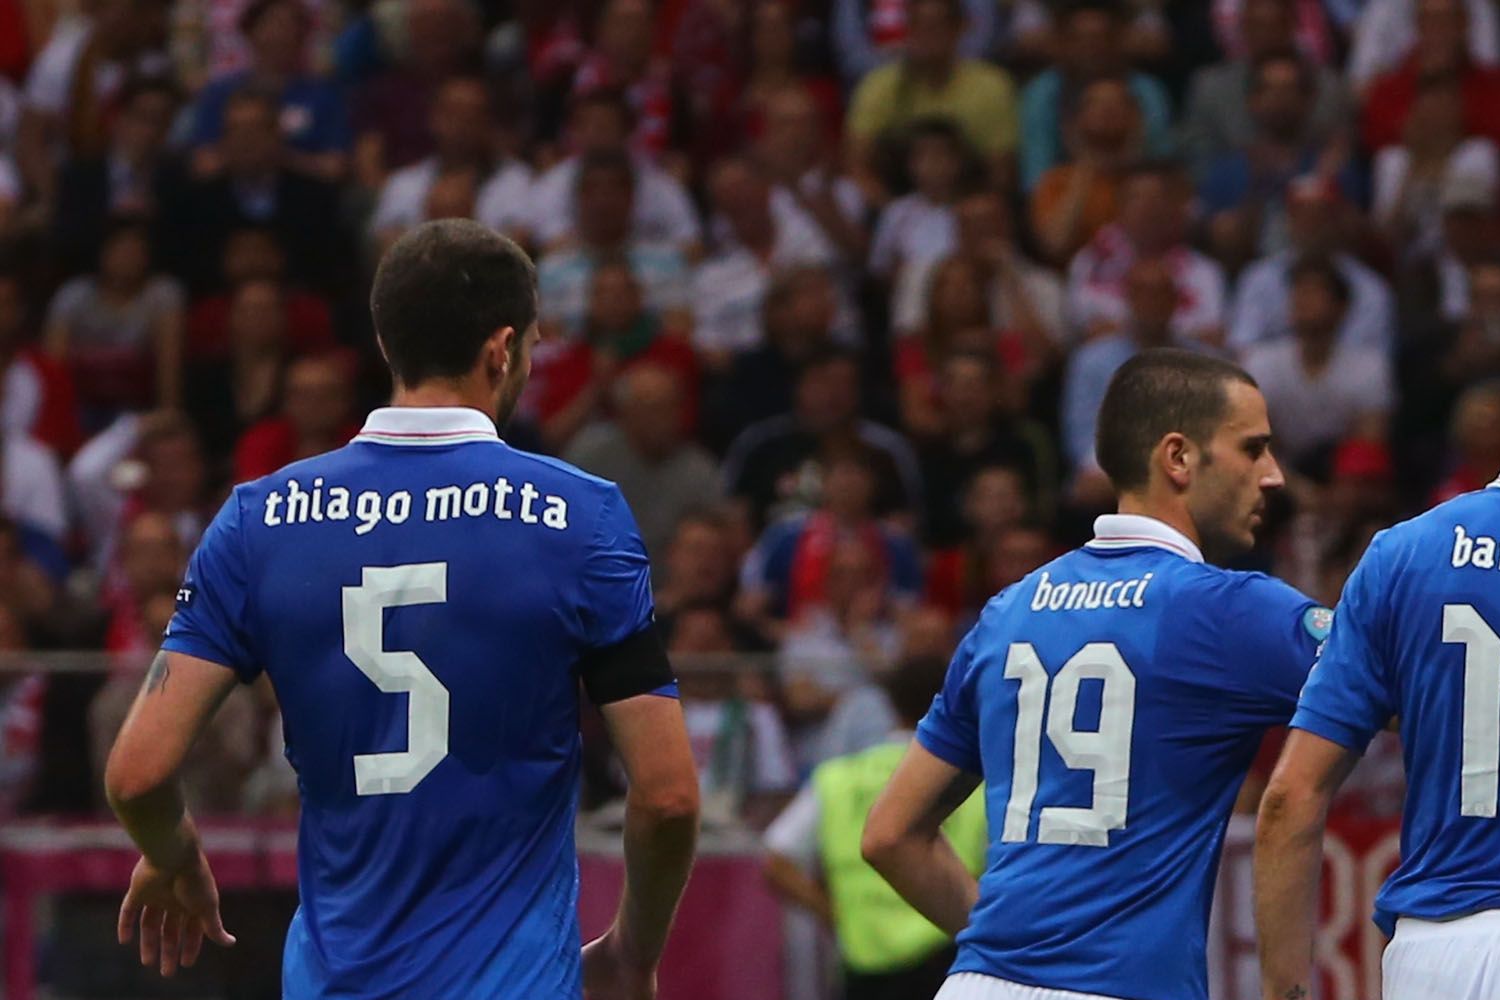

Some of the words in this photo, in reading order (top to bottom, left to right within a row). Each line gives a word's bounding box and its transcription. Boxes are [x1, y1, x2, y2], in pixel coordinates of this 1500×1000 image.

[263, 476, 412, 536] thiago
[424, 476, 569, 531] motta
[1029, 570, 1155, 612] bonucci
[341, 561, 451, 797] 5
[1001, 641, 1137, 848] 19
